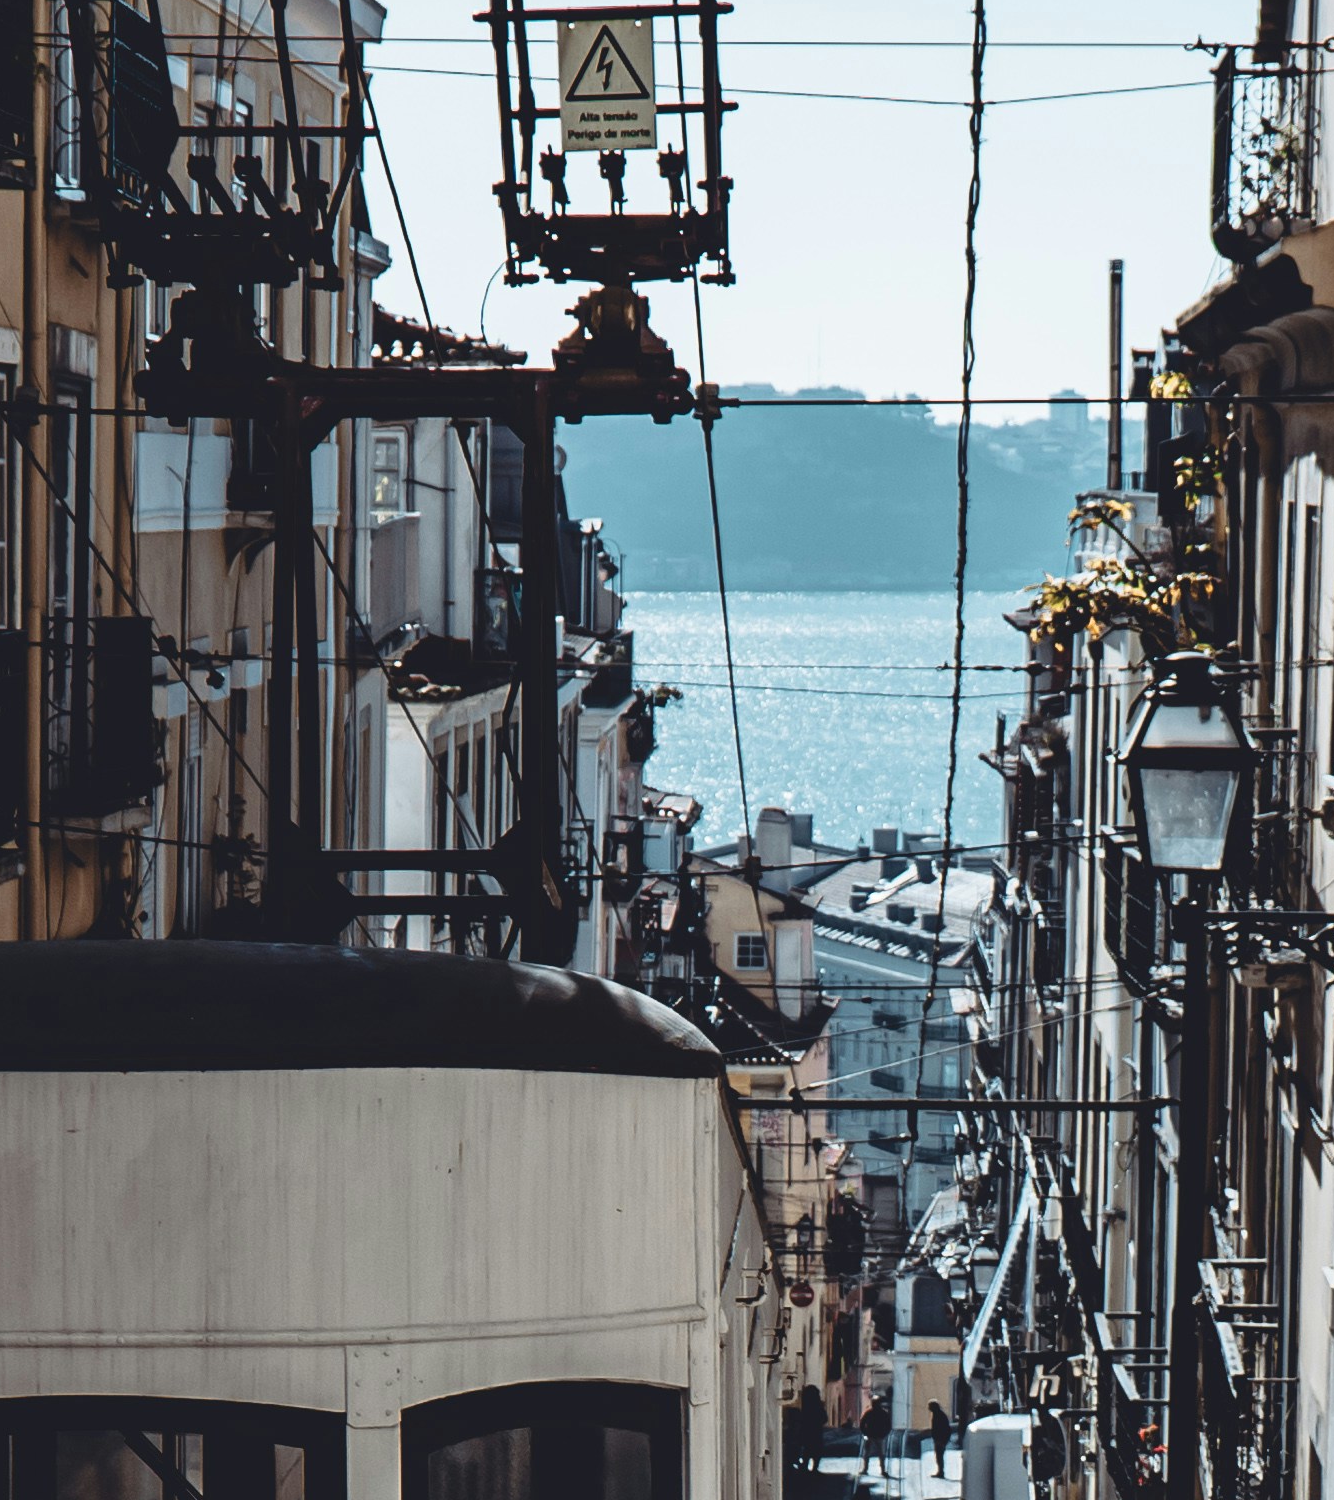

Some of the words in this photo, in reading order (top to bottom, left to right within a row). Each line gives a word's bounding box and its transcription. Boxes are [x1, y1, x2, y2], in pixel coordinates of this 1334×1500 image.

[579, 112, 600, 123] Alta
[603, 110, 638, 121] tensão
[567, 128, 602, 141] Perigo
[604, 128, 617, 138] de
[620, 127, 651, 138] morte
